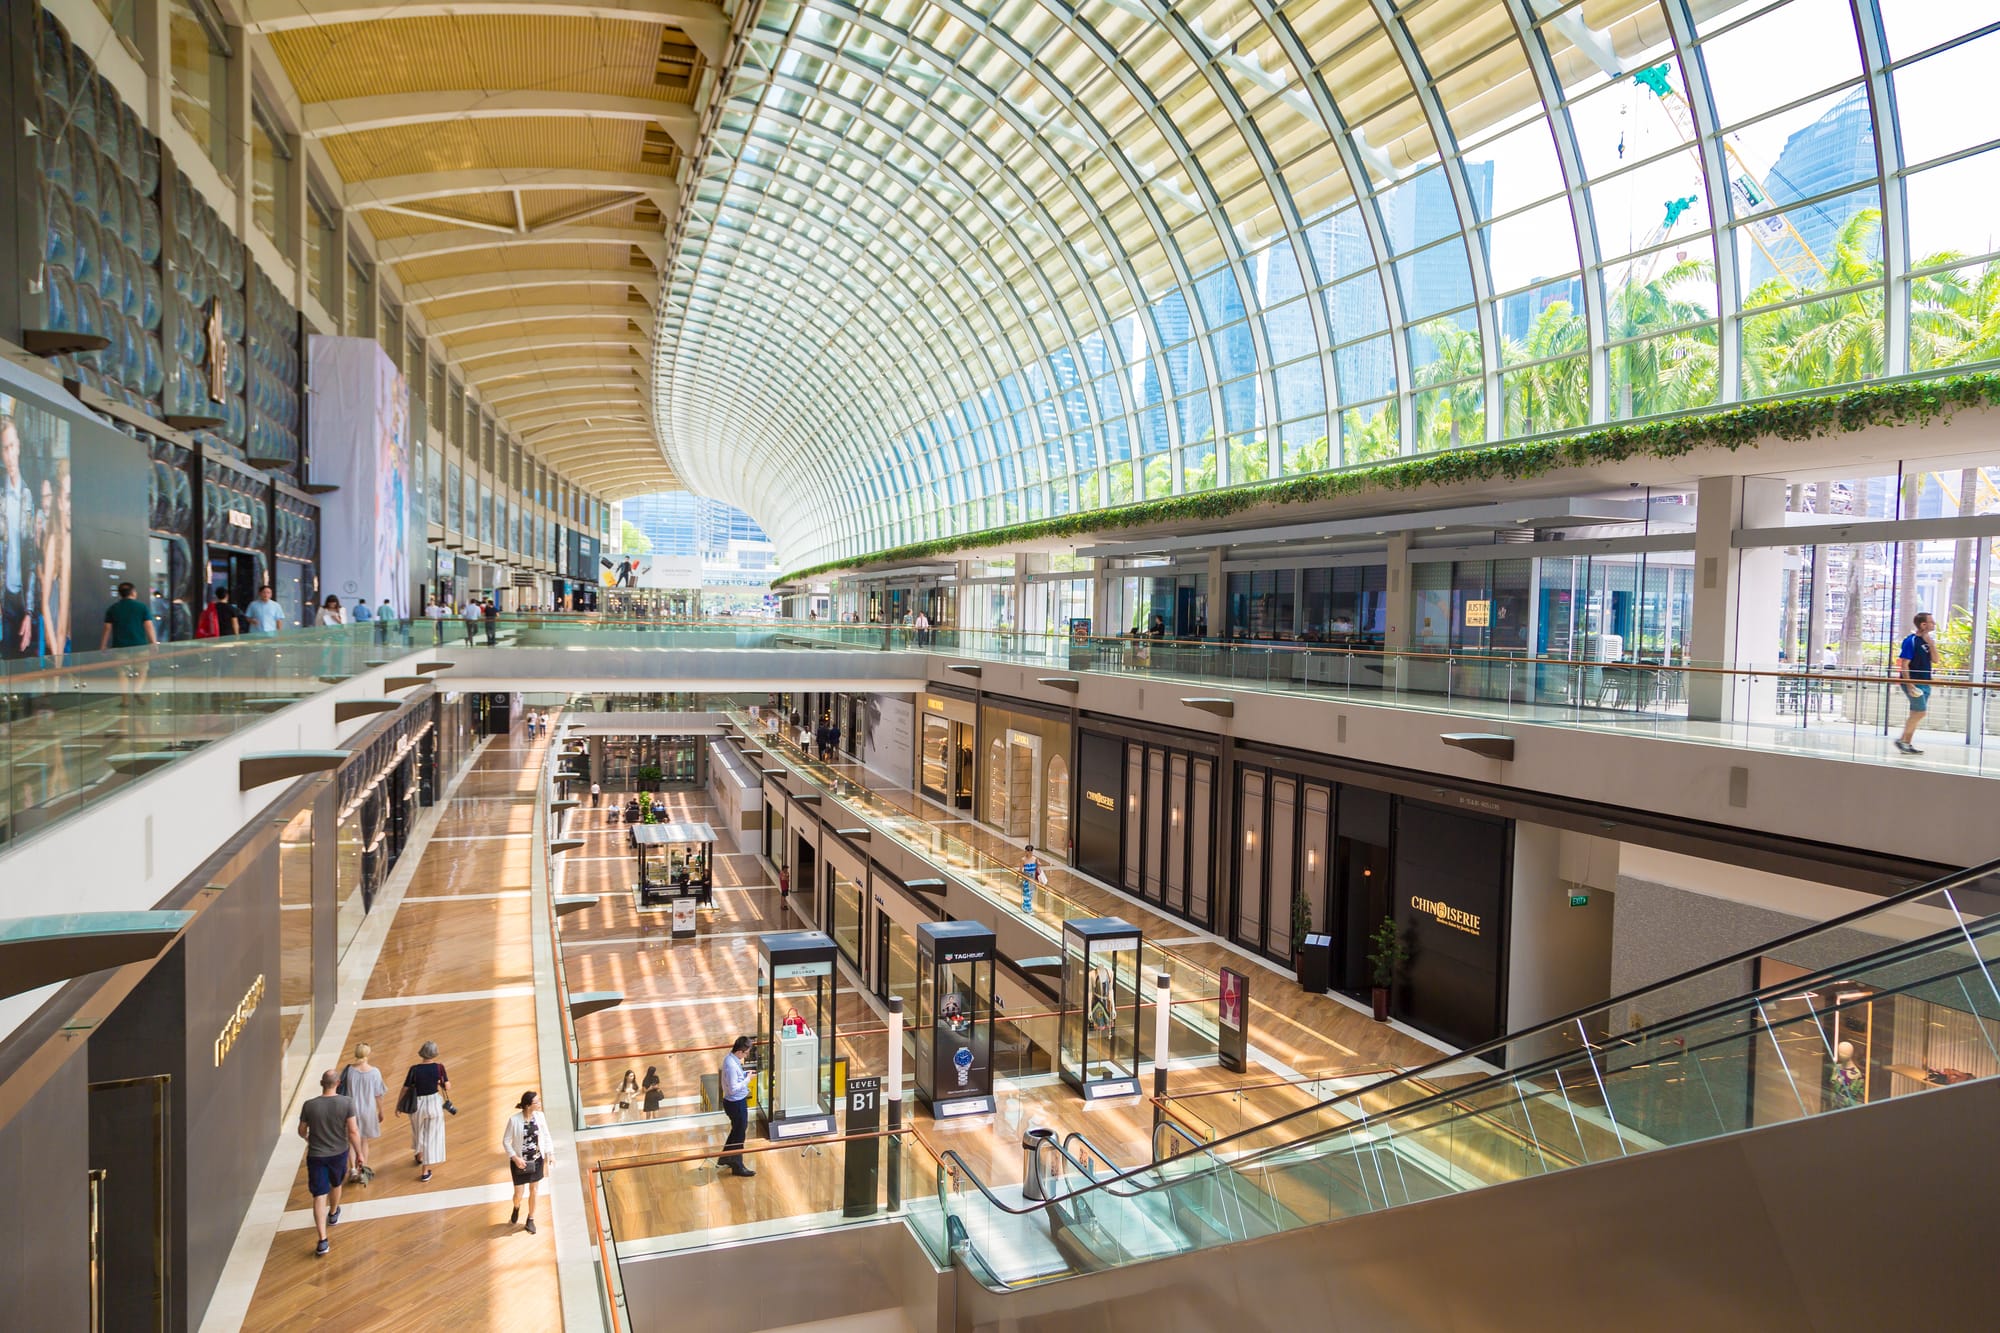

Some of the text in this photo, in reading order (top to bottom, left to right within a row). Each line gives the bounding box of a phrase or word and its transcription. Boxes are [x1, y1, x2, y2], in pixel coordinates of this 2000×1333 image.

[1467, 603, 1489, 611] JUSTIN
[1411, 896, 1481, 930] CHINOISERIE
[850, 1080, 878, 1089] LEVEL
[853, 1092, 874, 1111] B1
